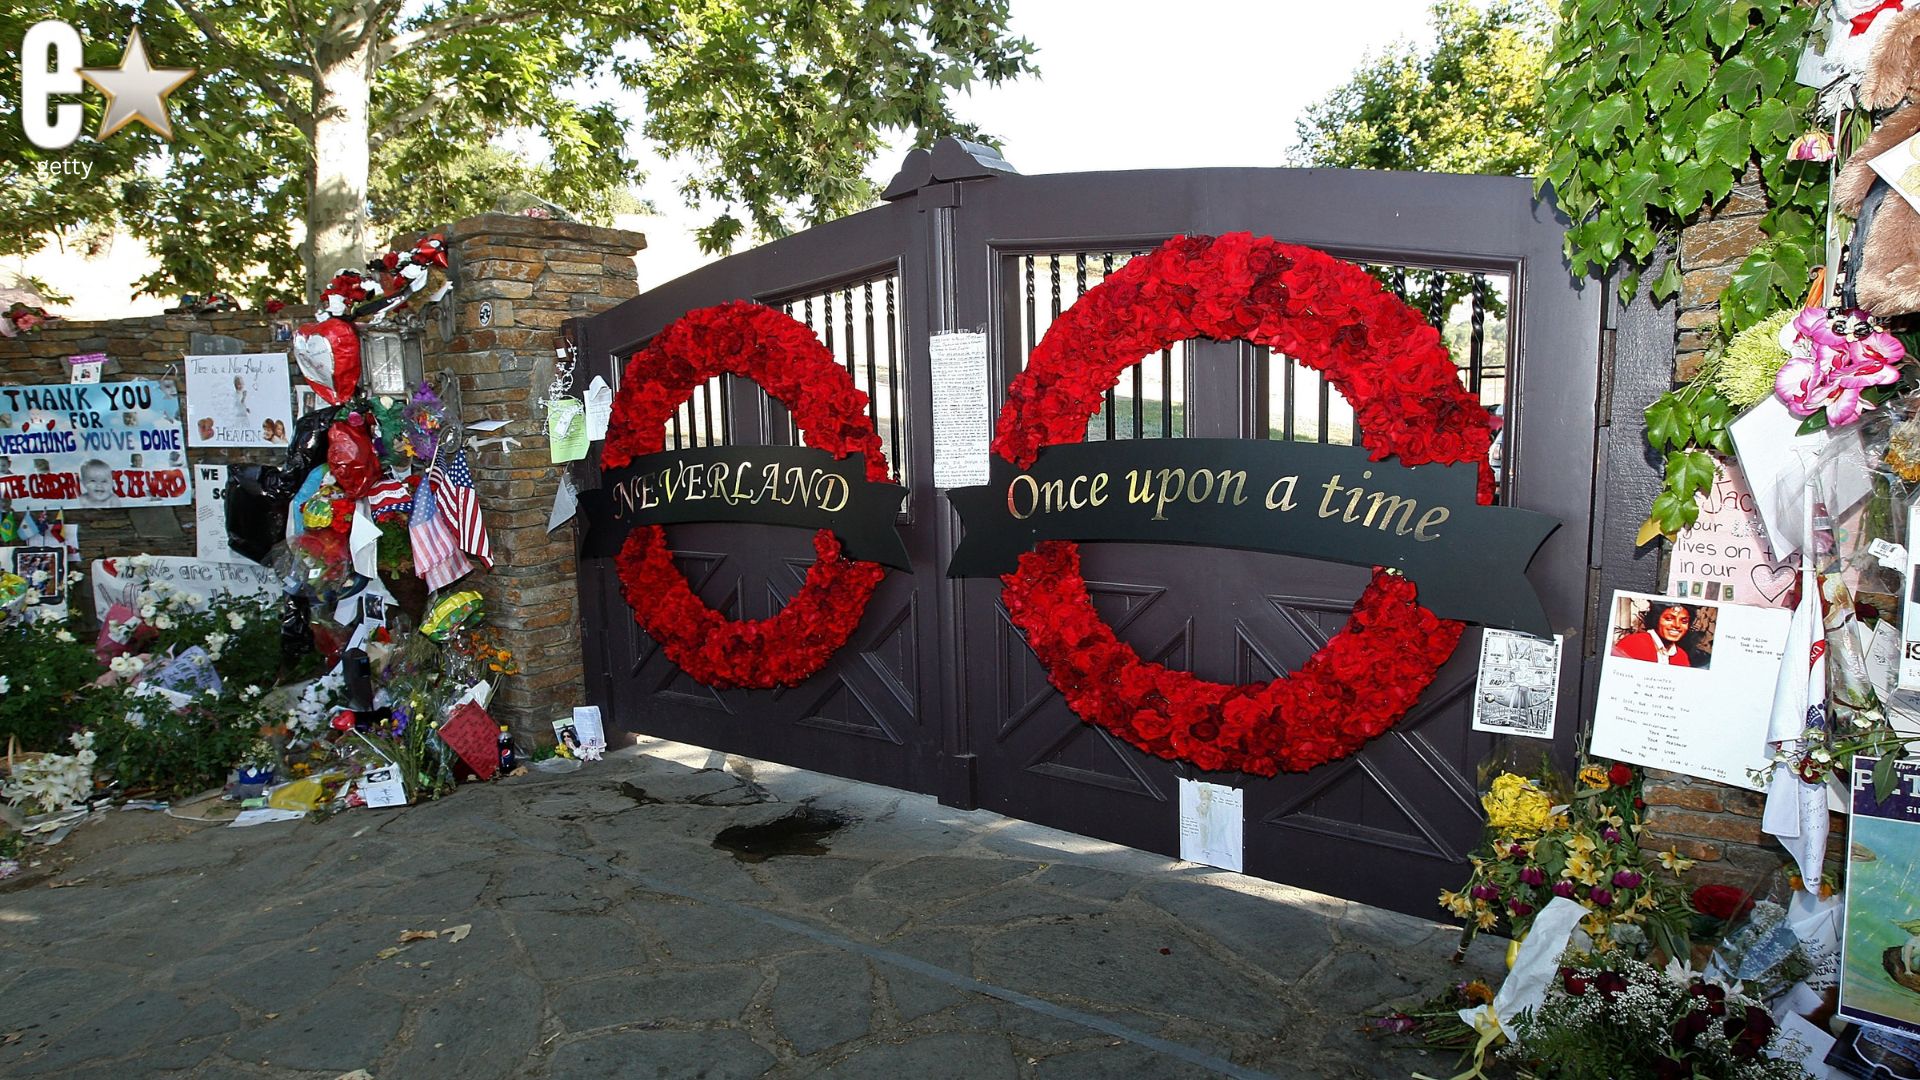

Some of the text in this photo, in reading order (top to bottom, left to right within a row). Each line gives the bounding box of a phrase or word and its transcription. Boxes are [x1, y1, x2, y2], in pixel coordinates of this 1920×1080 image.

[3, 385, 152, 412] THANK YOU
[69, 411, 104, 429] FOR
[80, 428, 135, 451] YOU'VE
[140, 429, 181, 451] DONE
[216, 427, 261, 442] HEAVEN
[201, 468, 219, 480] WE
[613, 460, 850, 520] NEVERLAND
[1007, 467, 1450, 542] Once upon a time
[1678, 538, 1717, 556] lives
[1724, 546, 1751, 559] on
[179, 565, 212, 582] are
[216, 563, 248, 584] the
[1680, 558, 1737, 577] in our
